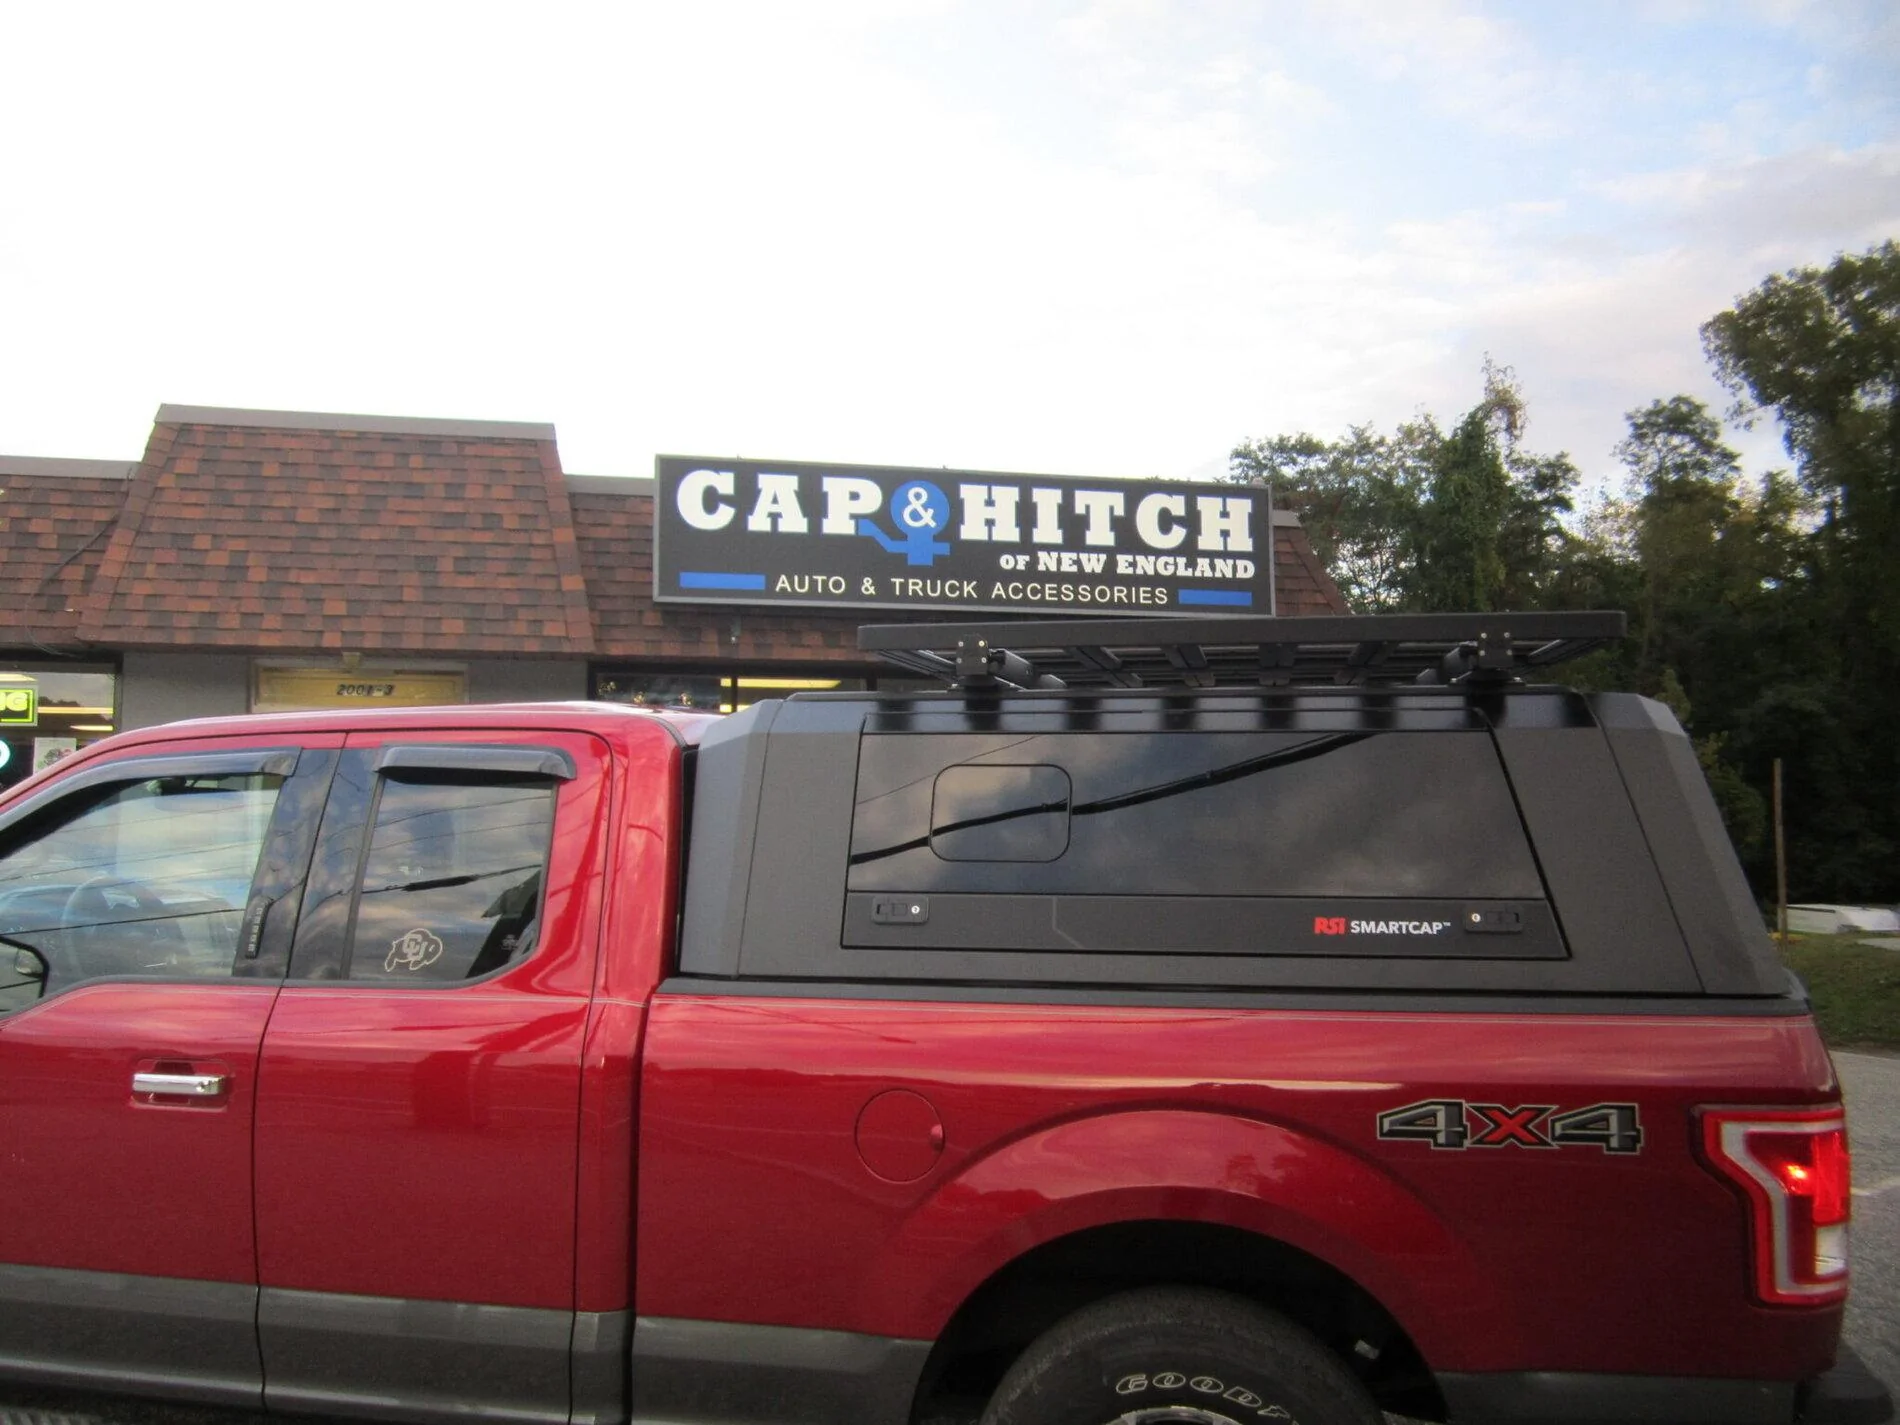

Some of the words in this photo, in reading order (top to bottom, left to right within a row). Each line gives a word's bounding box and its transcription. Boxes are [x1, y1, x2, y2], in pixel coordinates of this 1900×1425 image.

[676, 469, 883, 535] CAP
[902, 486, 937, 528] &
[959, 483, 1254, 552] HITCH
[1037, 551, 1107, 574] NEW
[1116, 554, 1256, 579] ENGLAND
[775, 574, 846, 594] AUTO
[861, 577, 877, 596] &
[890, 578, 978, 599] TRUCK
[991, 582, 1169, 605] ACCESSORIES
[1376, 1099, 1644, 1155] 4X4
